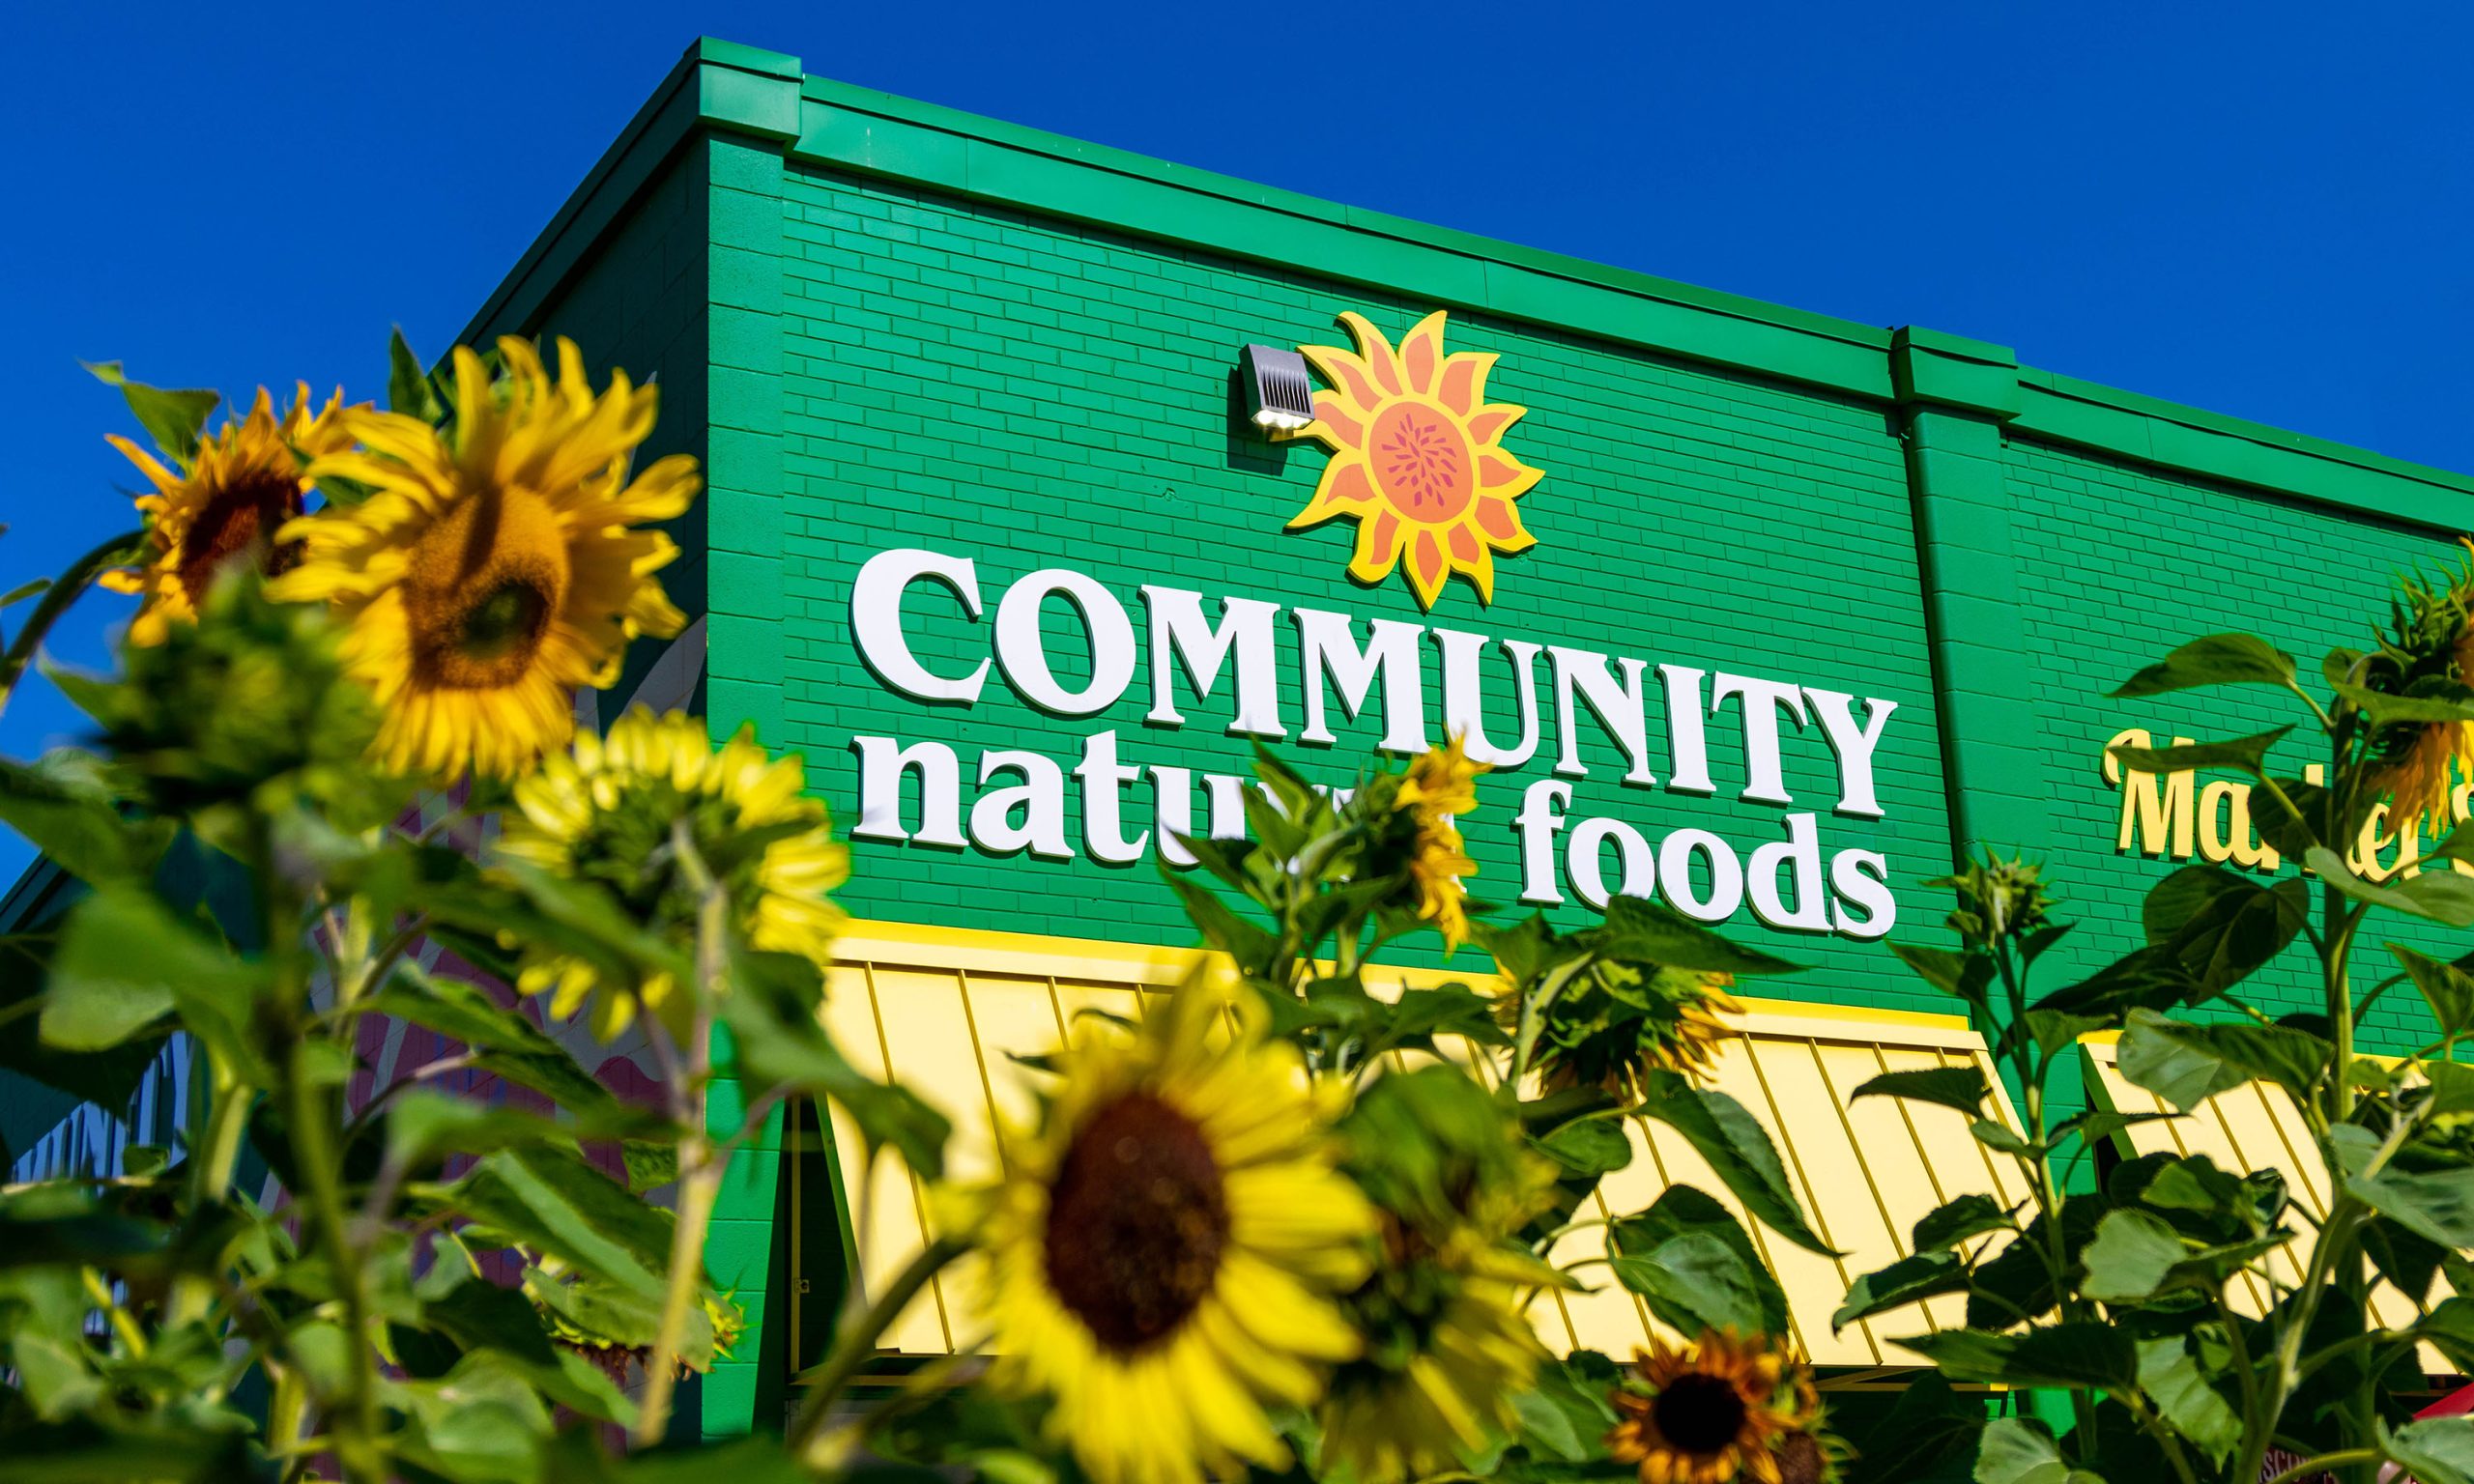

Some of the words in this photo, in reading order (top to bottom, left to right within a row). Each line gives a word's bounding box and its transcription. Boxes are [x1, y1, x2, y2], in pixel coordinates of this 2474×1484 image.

[849, 547, 1899, 817] COMMUNITY
[849, 728, 1468, 894] natu
[1512, 779, 1897, 938] foods
